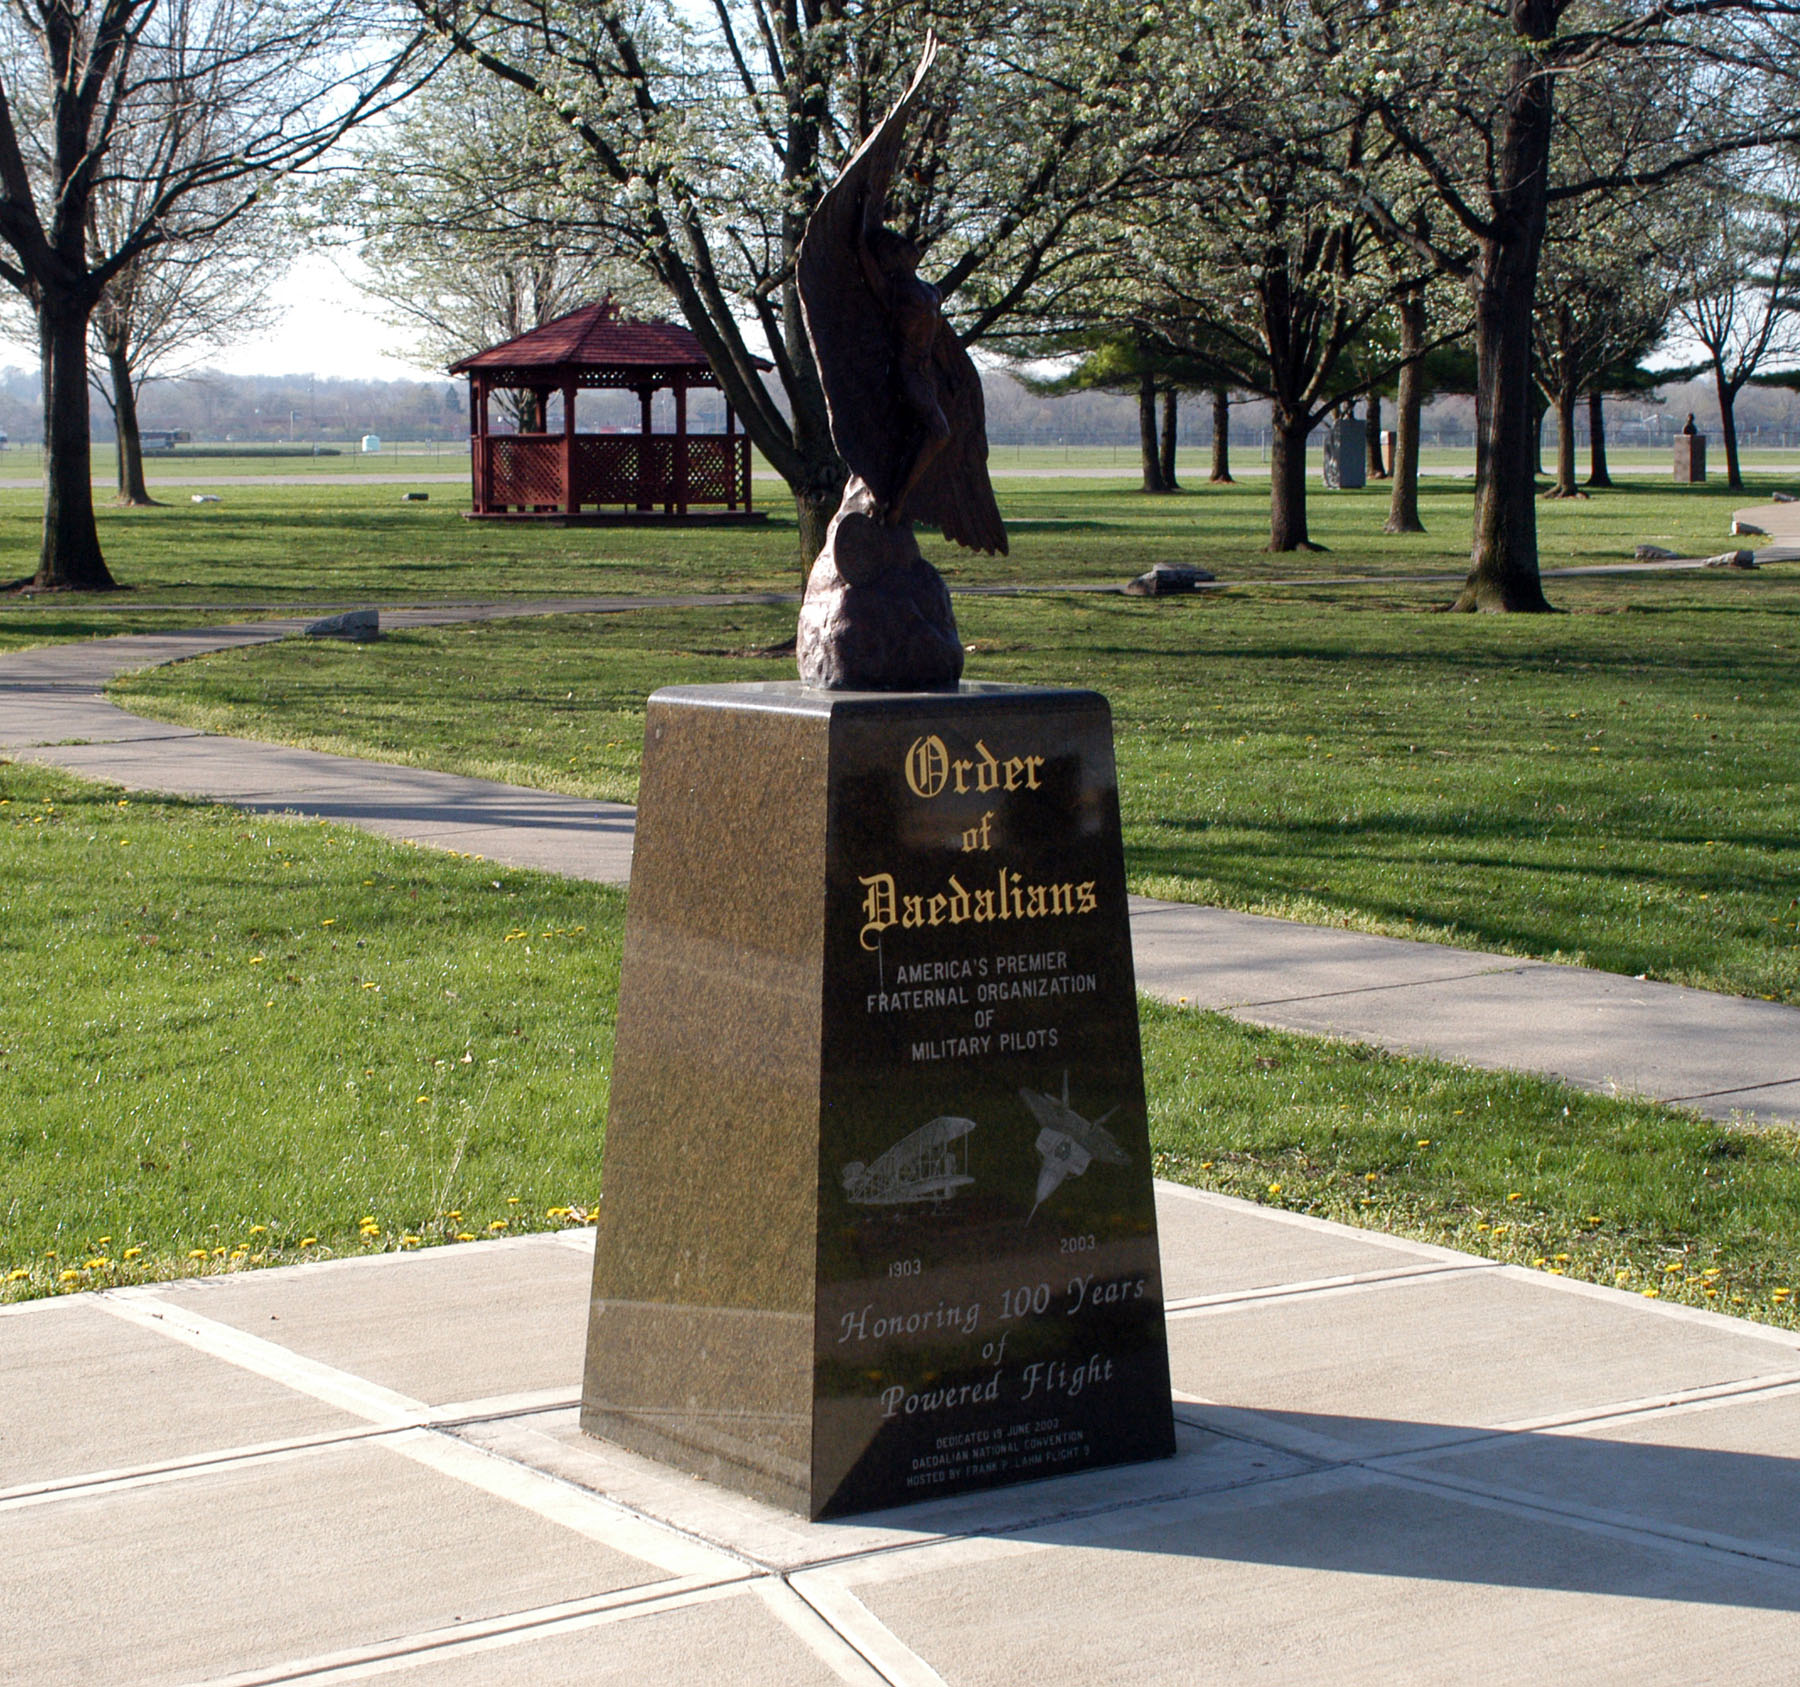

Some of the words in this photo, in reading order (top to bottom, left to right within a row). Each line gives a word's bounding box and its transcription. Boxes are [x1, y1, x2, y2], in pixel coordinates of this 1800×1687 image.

[905, 734, 1045, 798] Order
[961, 810, 995, 853] of
[858, 866, 1098, 951] Daedalians
[897, 957, 989, 984] AMERICA'S
[996, 951, 1068, 976] PREMIER
[867, 985, 969, 1013] FRATERNAL
[977, 974, 1097, 1002] ORGANIZATION
[975, 1009, 994, 1029] OF
[911, 1035, 991, 1061] MILITARY
[1000, 1028, 1059, 1052] PILOTS
[1060, 1234, 1096, 1254] 2003
[888, 1259, 922, 1279] 1903
[838, 1301, 980, 1343] Honoring
[999, 1282, 1050, 1321] 100
[1066, 1274, 1145, 1315] Years
[981, 1330, 1009, 1366] of
[880, 1369, 1000, 1419] Powered
[1021, 1353, 1114, 1401] Flight
[936, 1431, 990, 1450] DEDICATED
[1007, 1422, 1031, 1437] JUNE
[1034, 1418, 1060, 1431] 2003
[972, 1443, 1020, 1460] NATIONAL
[1024, 1430, 1084, 1450] CONVENTION
[906, 1471, 946, 1488] HOSTED
